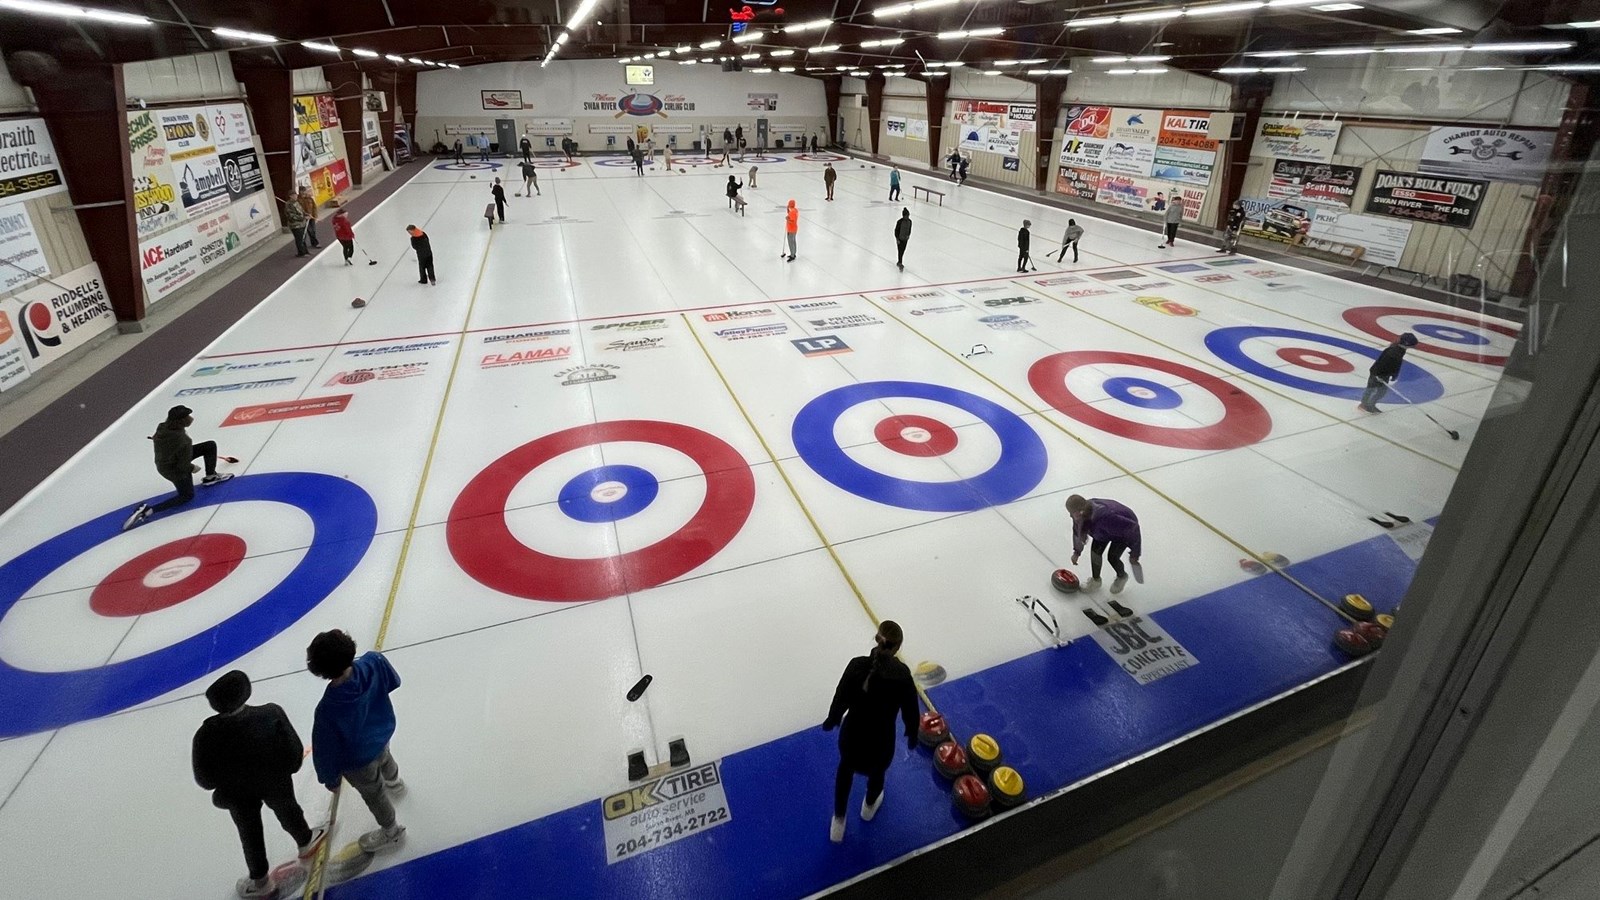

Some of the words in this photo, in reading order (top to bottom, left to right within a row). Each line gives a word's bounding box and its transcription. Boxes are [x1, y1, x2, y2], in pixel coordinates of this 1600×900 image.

[584, 102, 600, 110] SWAN
[601, 102, 617, 110] RIVER
[664, 102, 682, 110] CURLING
[1081, 114, 1095, 128] DQ
[1166, 118, 1188, 128] KAL
[1189, 119, 1210, 130] TIR
[163, 122, 196, 141] LIONS
[1443, 130, 1480, 144] CHARIOT
[1508, 133, 1537, 150] REPAIR
[1160, 136, 1214, 148] 204-734-4088
[1060, 168, 1078, 180] Valley
[1184, 190, 1204, 200] VALLEY
[1306, 182, 1326, 192] Scott
[1328, 185, 1353, 196] Tibble
[1376, 174, 1414, 189] DOAK'S
[1414, 178, 1444, 193] BULK
[1444, 181, 1482, 200] FUELS
[1374, 196, 1396, 205] SWAN
[1398, 199, 1422, 208] RIVER
[1434, 204, 1451, 213] THE
[1452, 206, 1470, 216] PAS
[143, 245, 165, 270] ACE
[165, 240, 192, 258] Hardware
[202, 248, 225, 265] VENTURES
[51, 279, 99, 309] RIDDELL'S
[56, 290, 104, 321] PLUMBING
[726, 309, 772, 317] Home
[62, 323, 70, 334] &
[70, 302, 108, 329] HEATING
[590, 319, 666, 330] SPICER
[484, 329, 570, 341] RICHARDSON
[800, 338, 837, 351] LP
[481, 347, 571, 363] FLAMAN
[1104, 616, 1164, 655] JBC
[1122, 645, 1186, 675] CONCRETE
[1140, 660, 1191, 683] SPECIALIST
[603, 780, 663, 821] OK
[666, 766, 716, 794] TIRE
[630, 808, 659, 827] auto
[662, 792, 706, 815] service
[616, 807, 727, 857] 204-734-2722
